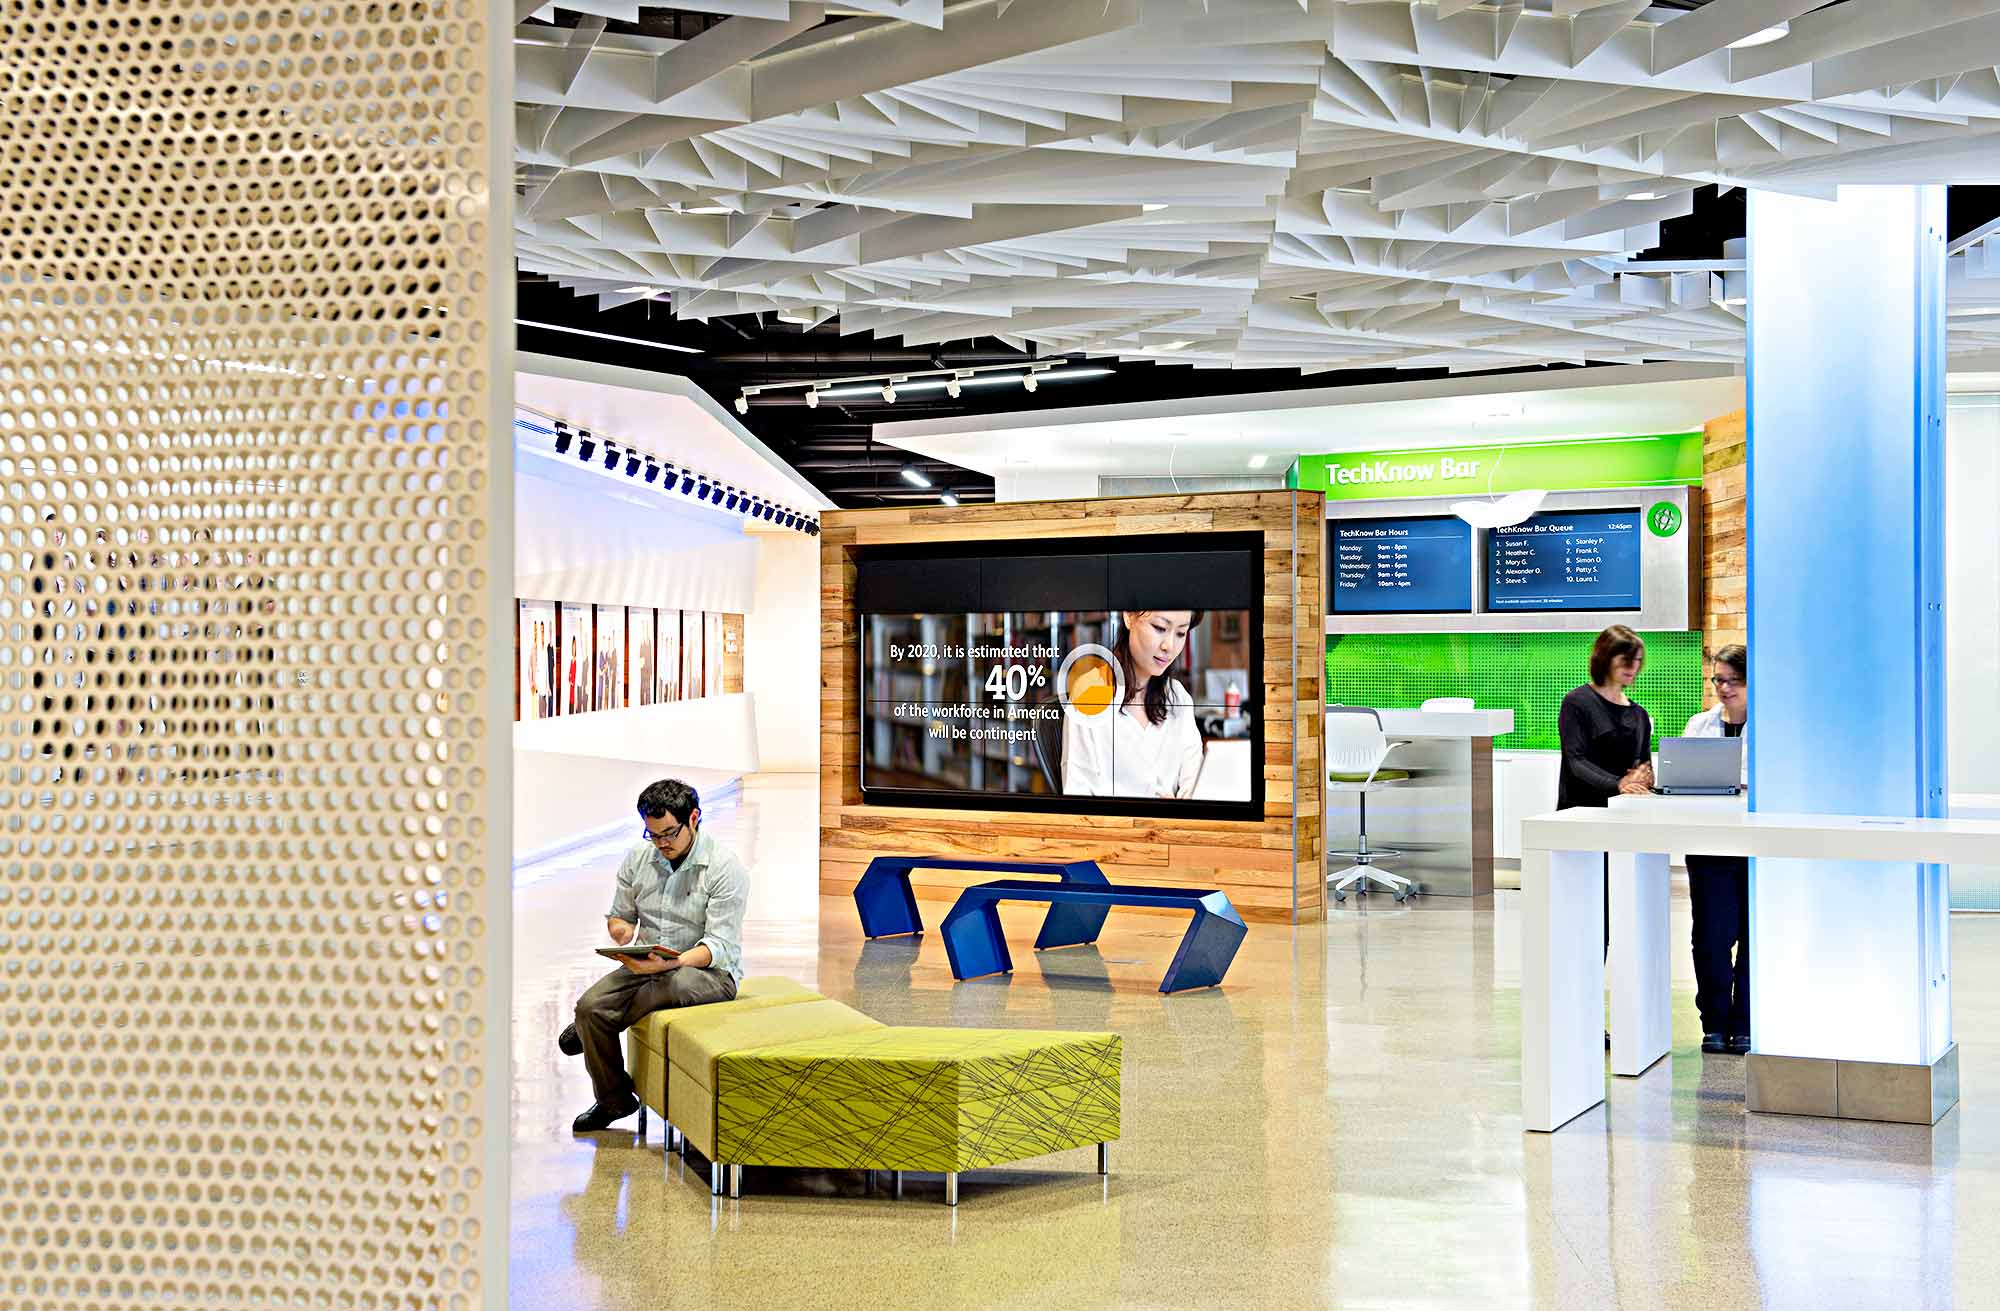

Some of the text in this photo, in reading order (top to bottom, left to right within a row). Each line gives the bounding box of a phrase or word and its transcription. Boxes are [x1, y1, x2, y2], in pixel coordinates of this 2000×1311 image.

[1325, 458, 1480, 484] TechKnow Bar
[890, 644, 1060, 662] By 2020, it is estimated that
[985, 664, 1046, 701] 40%
[894, 704, 1059, 720] of the workforce in America
[929, 726, 1036, 744] will be contingent
